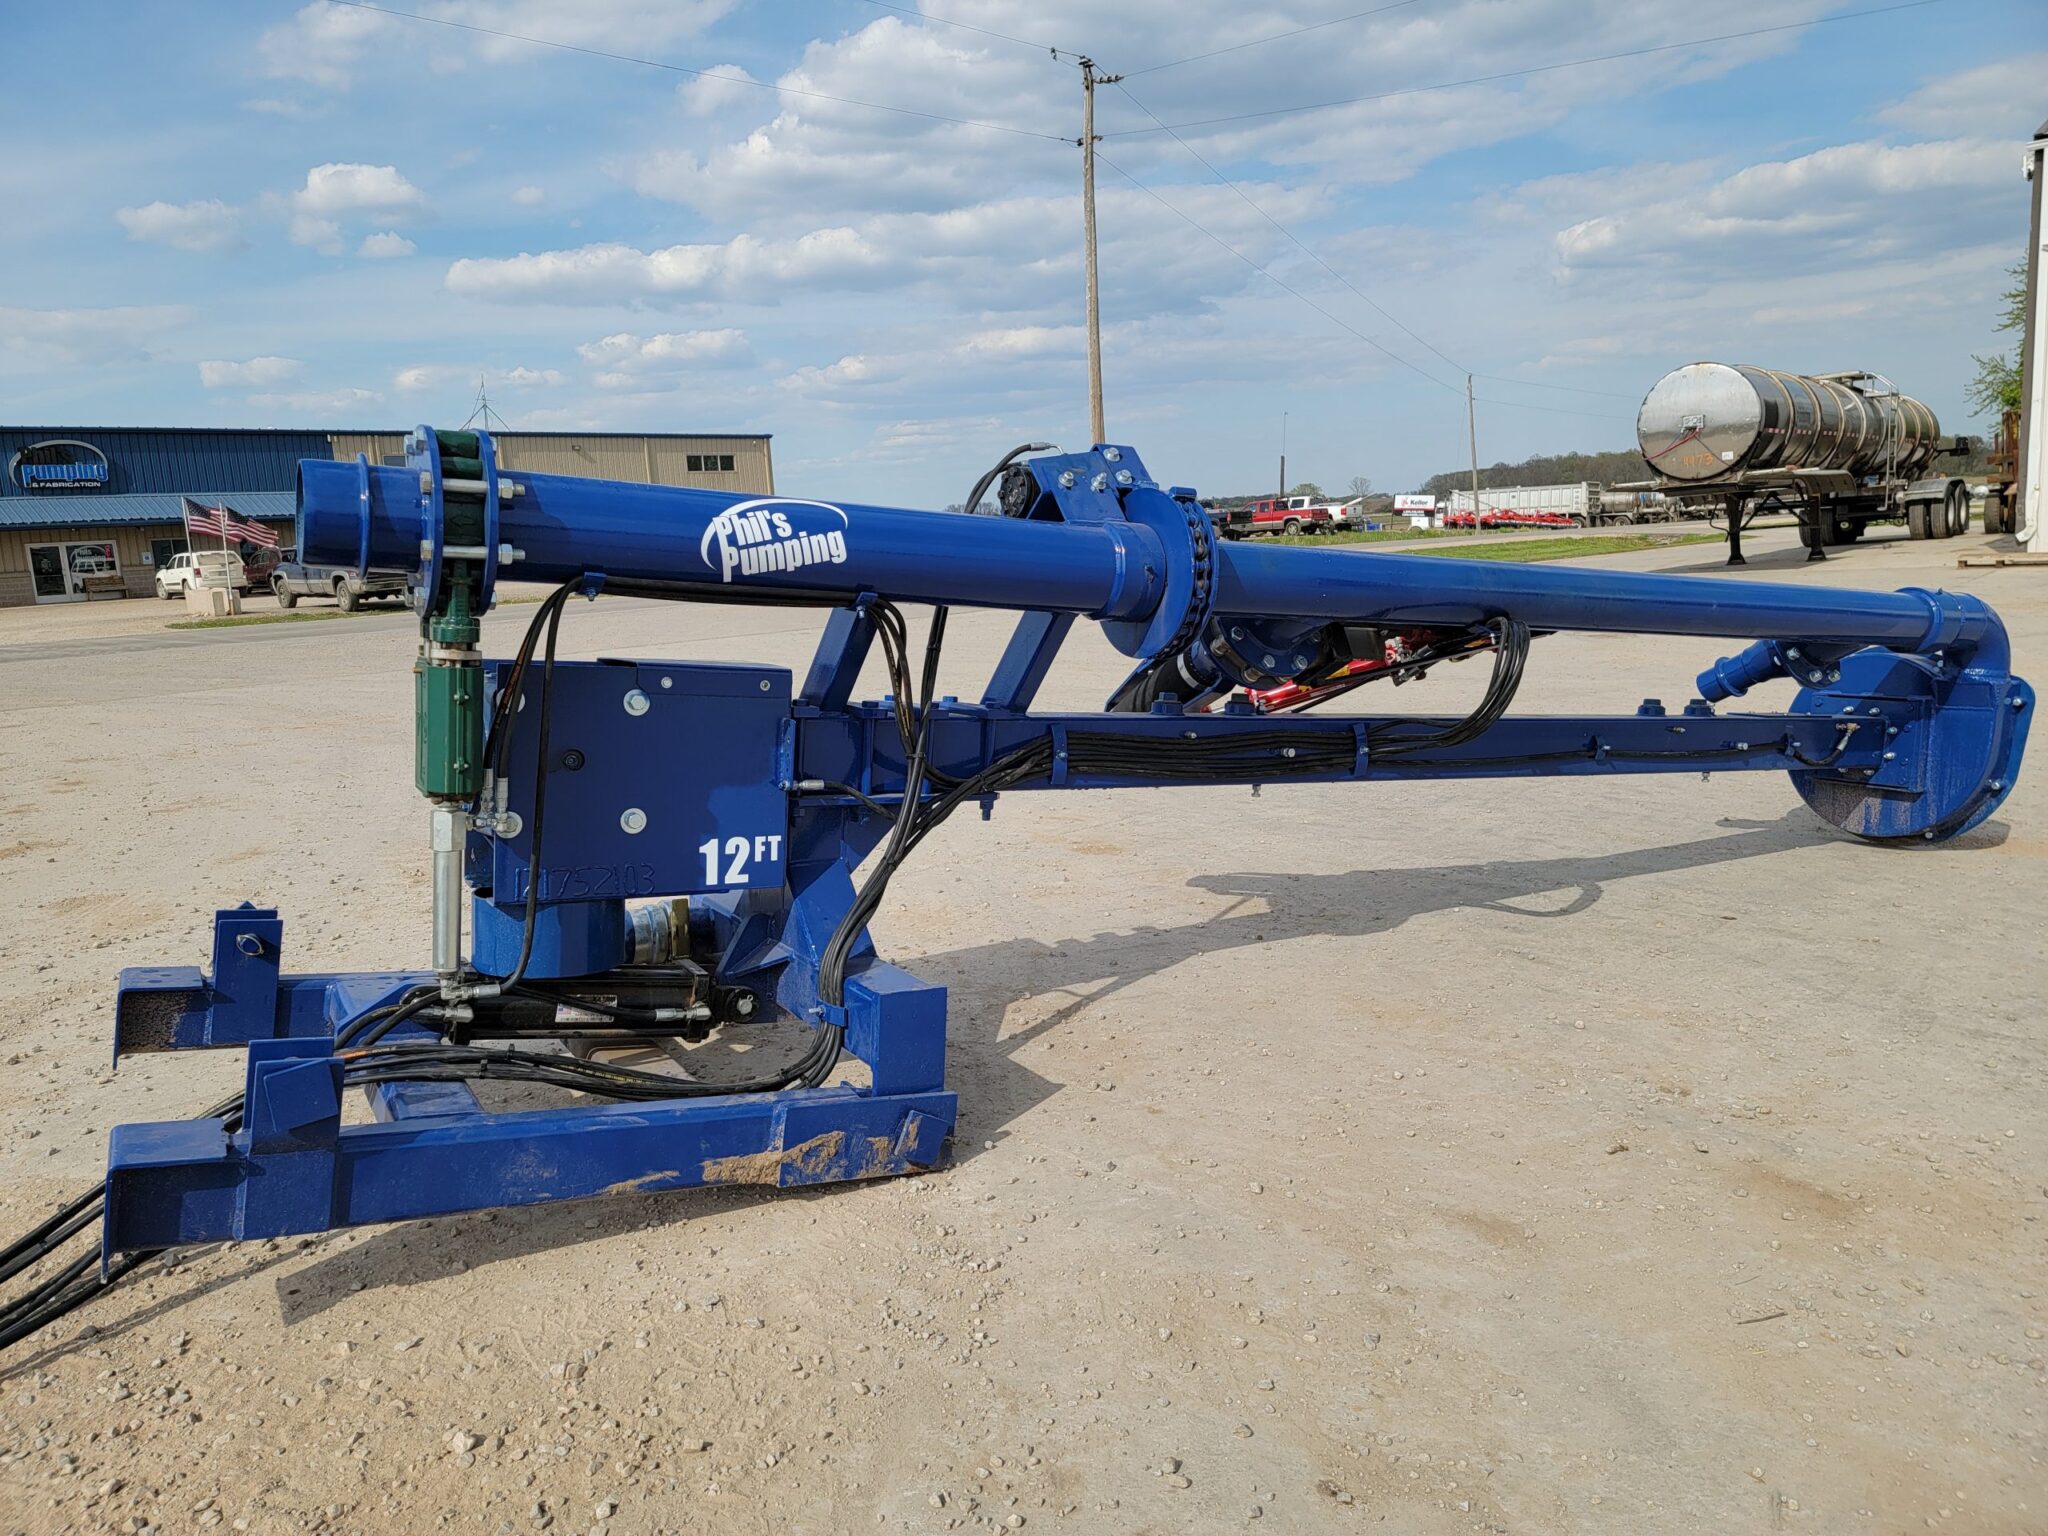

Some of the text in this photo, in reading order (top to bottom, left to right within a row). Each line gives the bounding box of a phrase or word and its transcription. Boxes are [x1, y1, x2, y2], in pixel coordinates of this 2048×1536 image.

[22, 462, 108, 488] Pumping
[712, 509, 793, 546] Phil's
[721, 530, 848, 583] Pumping
